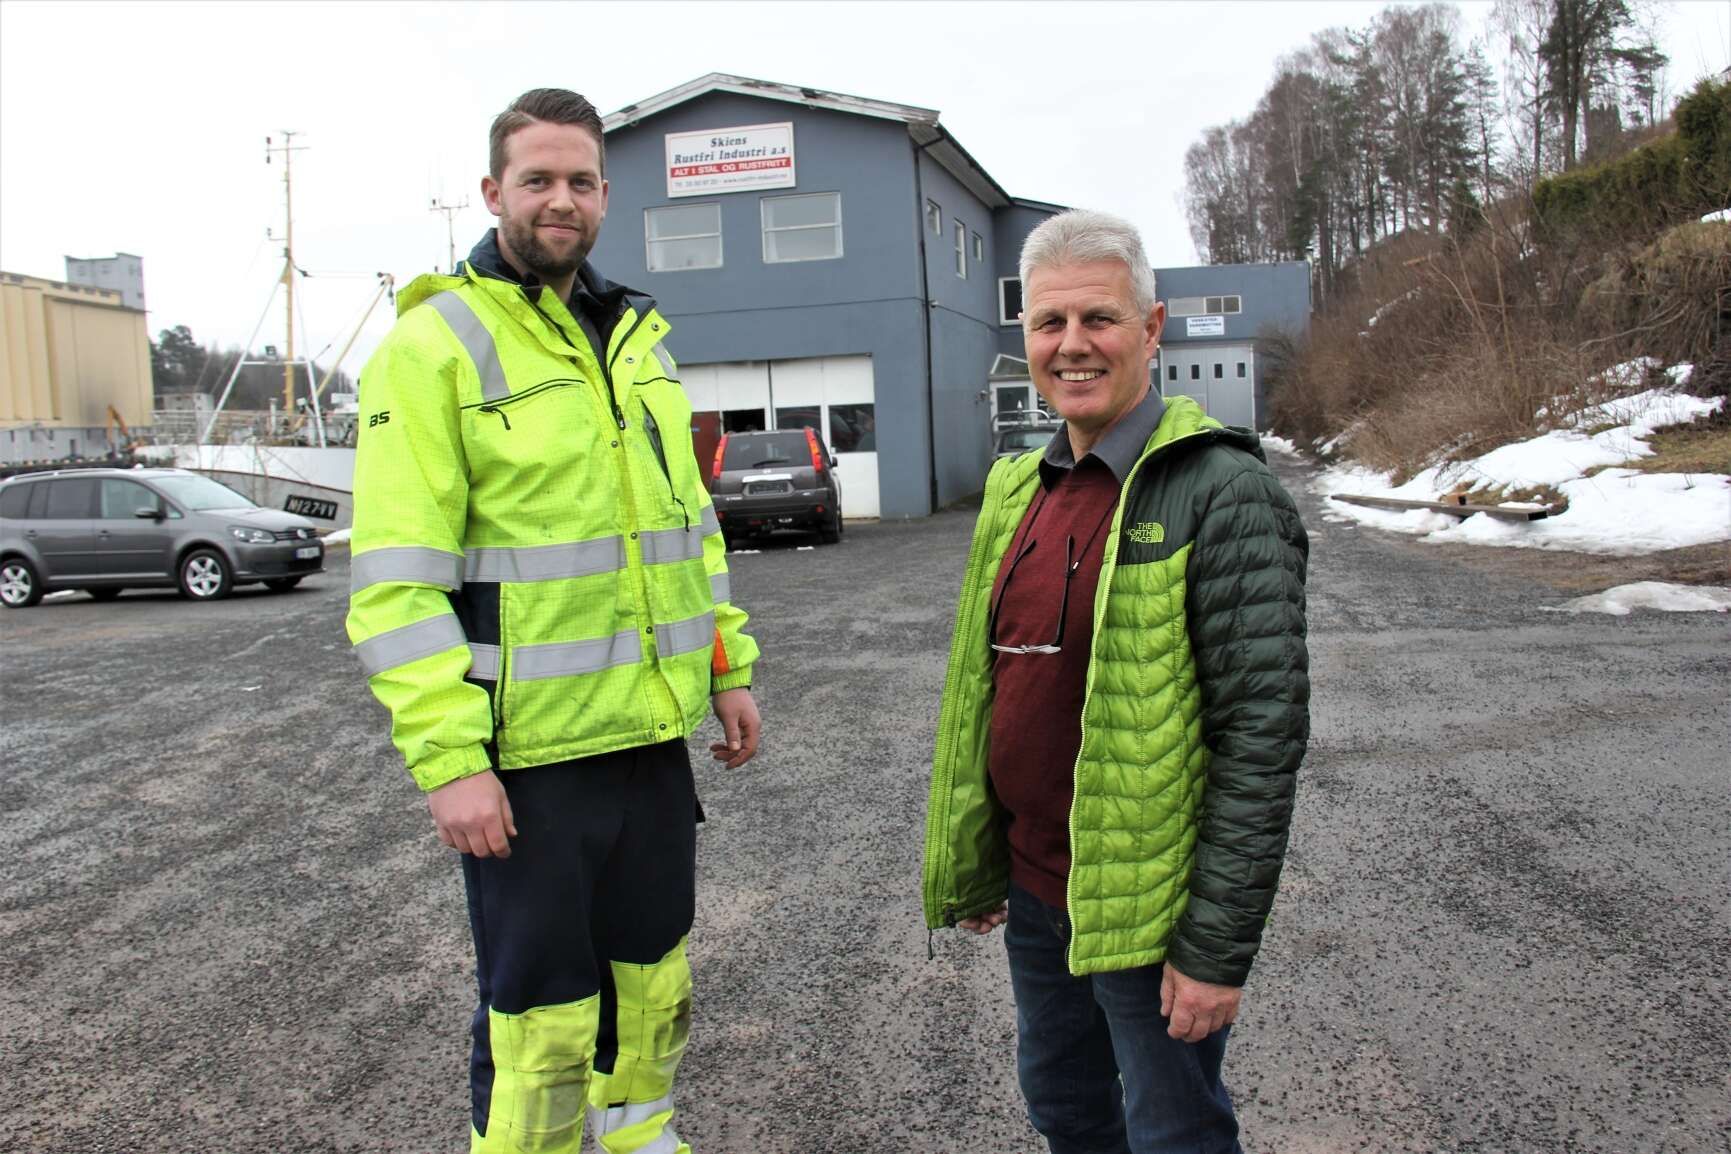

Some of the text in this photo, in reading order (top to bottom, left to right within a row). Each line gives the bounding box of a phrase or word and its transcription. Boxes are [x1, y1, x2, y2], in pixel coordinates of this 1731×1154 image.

[719, 146, 767, 160] Industri
[673, 167, 690, 176] ALT
[721, 163, 737, 172] OG
[738, 158, 787, 170] RUSTFRITT
[369, 410, 391, 428] BS
[1125, 528, 1152, 537] NORTH
[1137, 522, 1153, 530] THE
